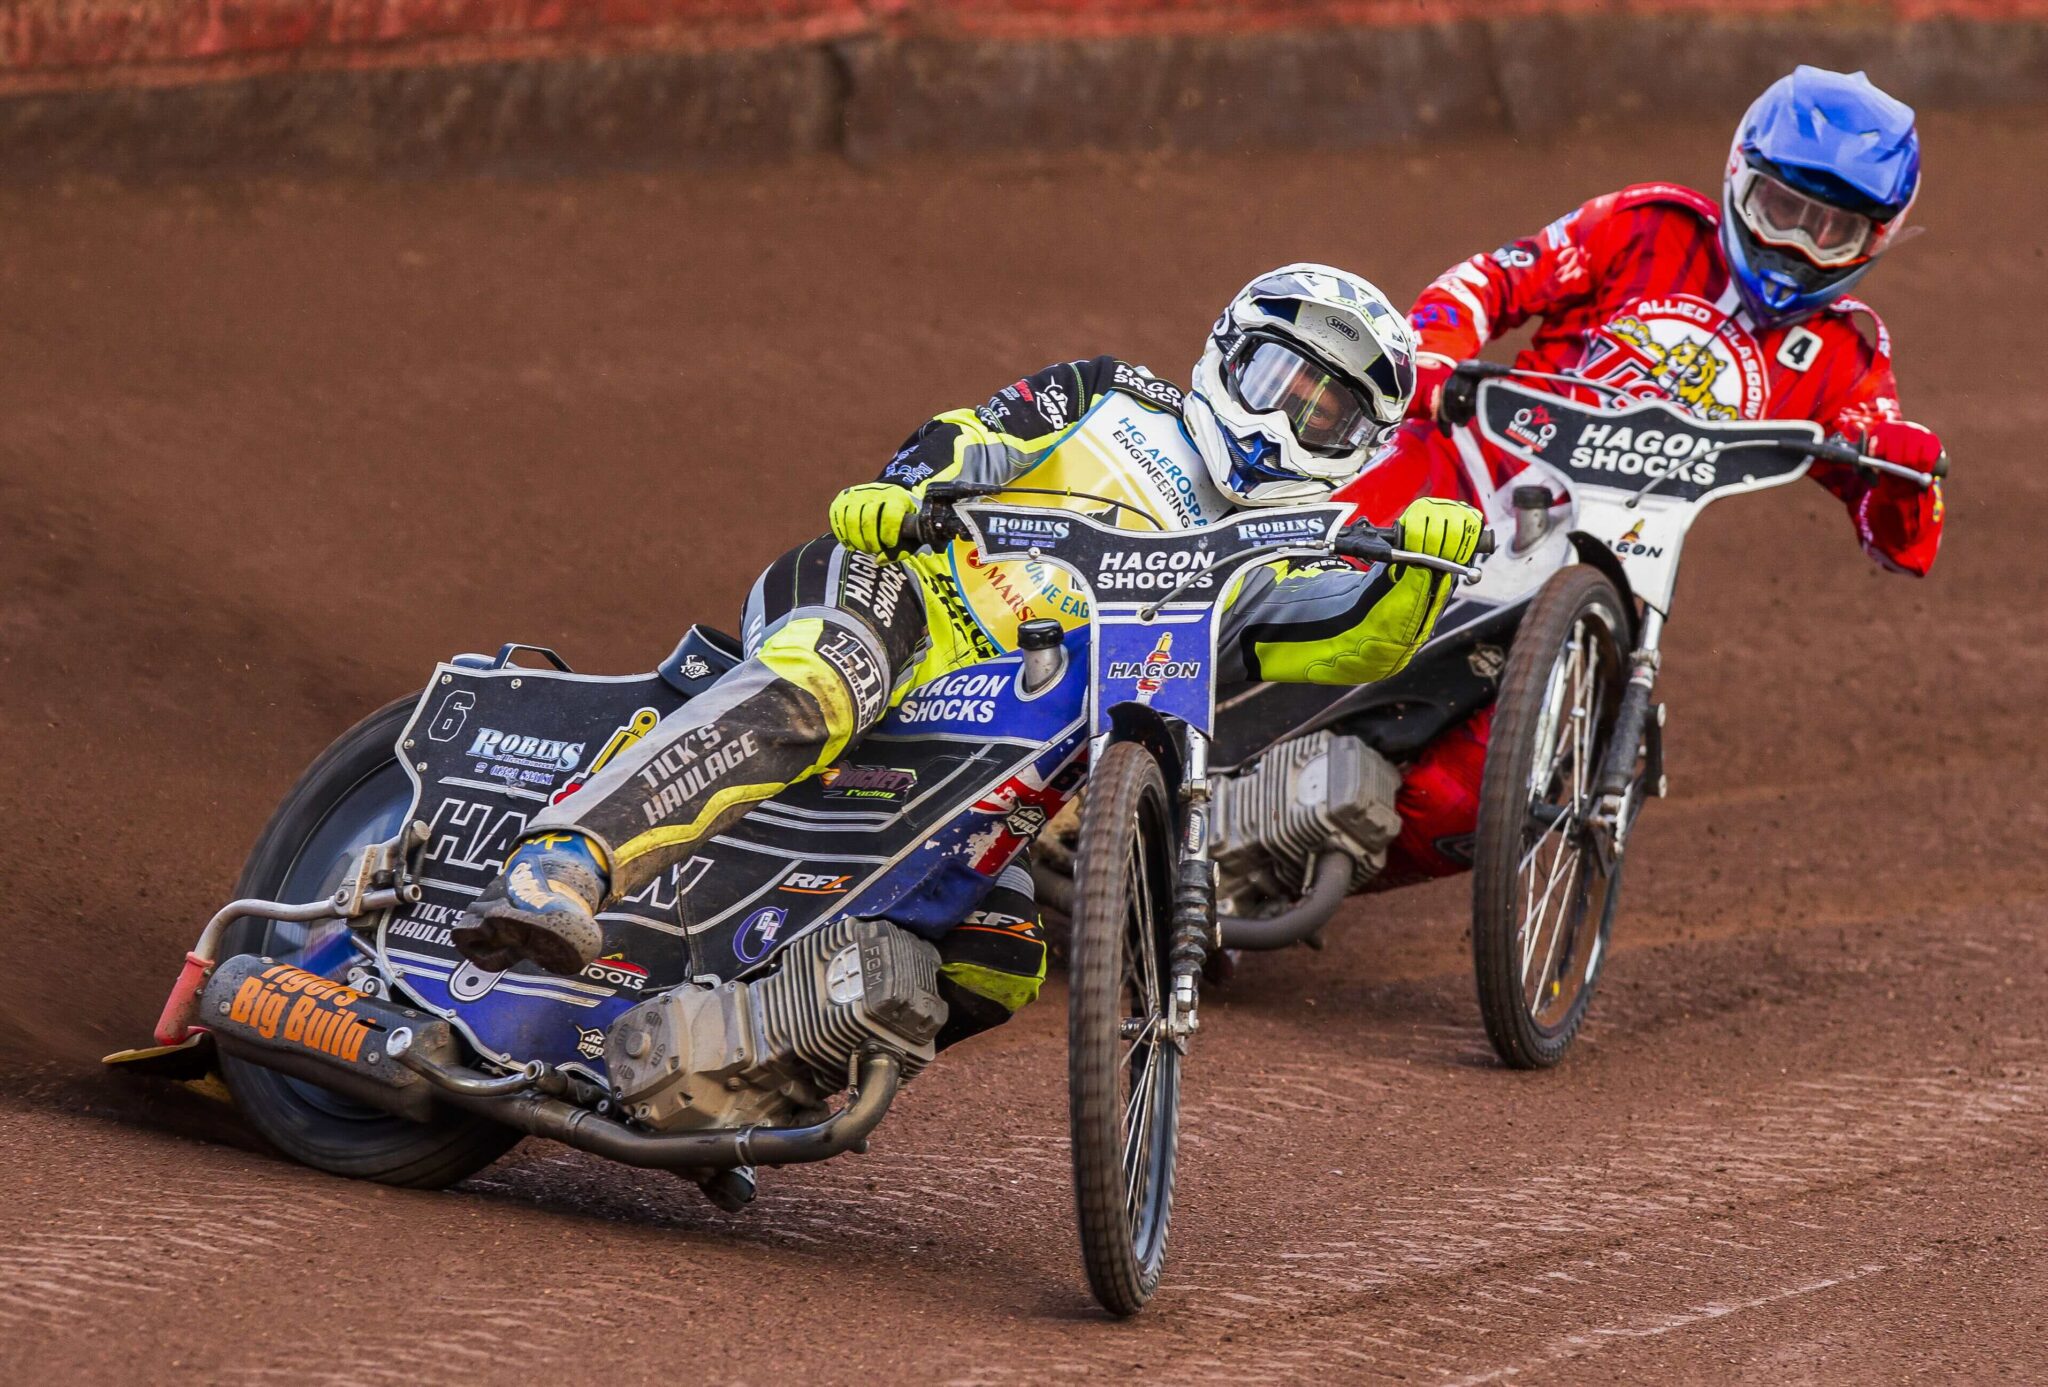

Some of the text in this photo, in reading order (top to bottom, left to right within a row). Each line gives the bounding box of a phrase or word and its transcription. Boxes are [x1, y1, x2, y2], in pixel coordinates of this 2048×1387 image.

[1330, 318, 1359, 340] SHOEI
[1637, 300, 1712, 323] ALLIED
[1787, 336, 1813, 365] 4
[1114, 374, 1184, 410] SHOCK
[1116, 365, 1185, 401] HAGO
[1577, 424, 1725, 463] HAGON
[1112, 430, 1191, 529] ENGINEERING
[1118, 417, 1209, 526] HG AEROSPA
[1570, 447, 1716, 485] SHOCKS
[987, 516, 1070, 538] ROBINS
[1236, 517, 1326, 541] ROBINS
[1099, 551, 1216, 571] HAGON
[1607, 540, 1663, 558] GON
[845, 550, 880, 608] HAGO
[873, 561, 907, 629] SHOCK
[983, 566, 1037, 621] MARS
[1097, 571, 1214, 589] SHOCKS
[1107, 662, 1200, 678] HAGON
[428, 690, 476, 742] 6
[899, 699, 996, 724] SHOCKS
[465, 727, 586, 772] ROBINS
[642, 724, 722, 789] TICK'S
[642, 730, 759, 826] HAULAGE
[388, 918, 456, 947] HAULA
[230, 976, 377, 1062] Big Build
